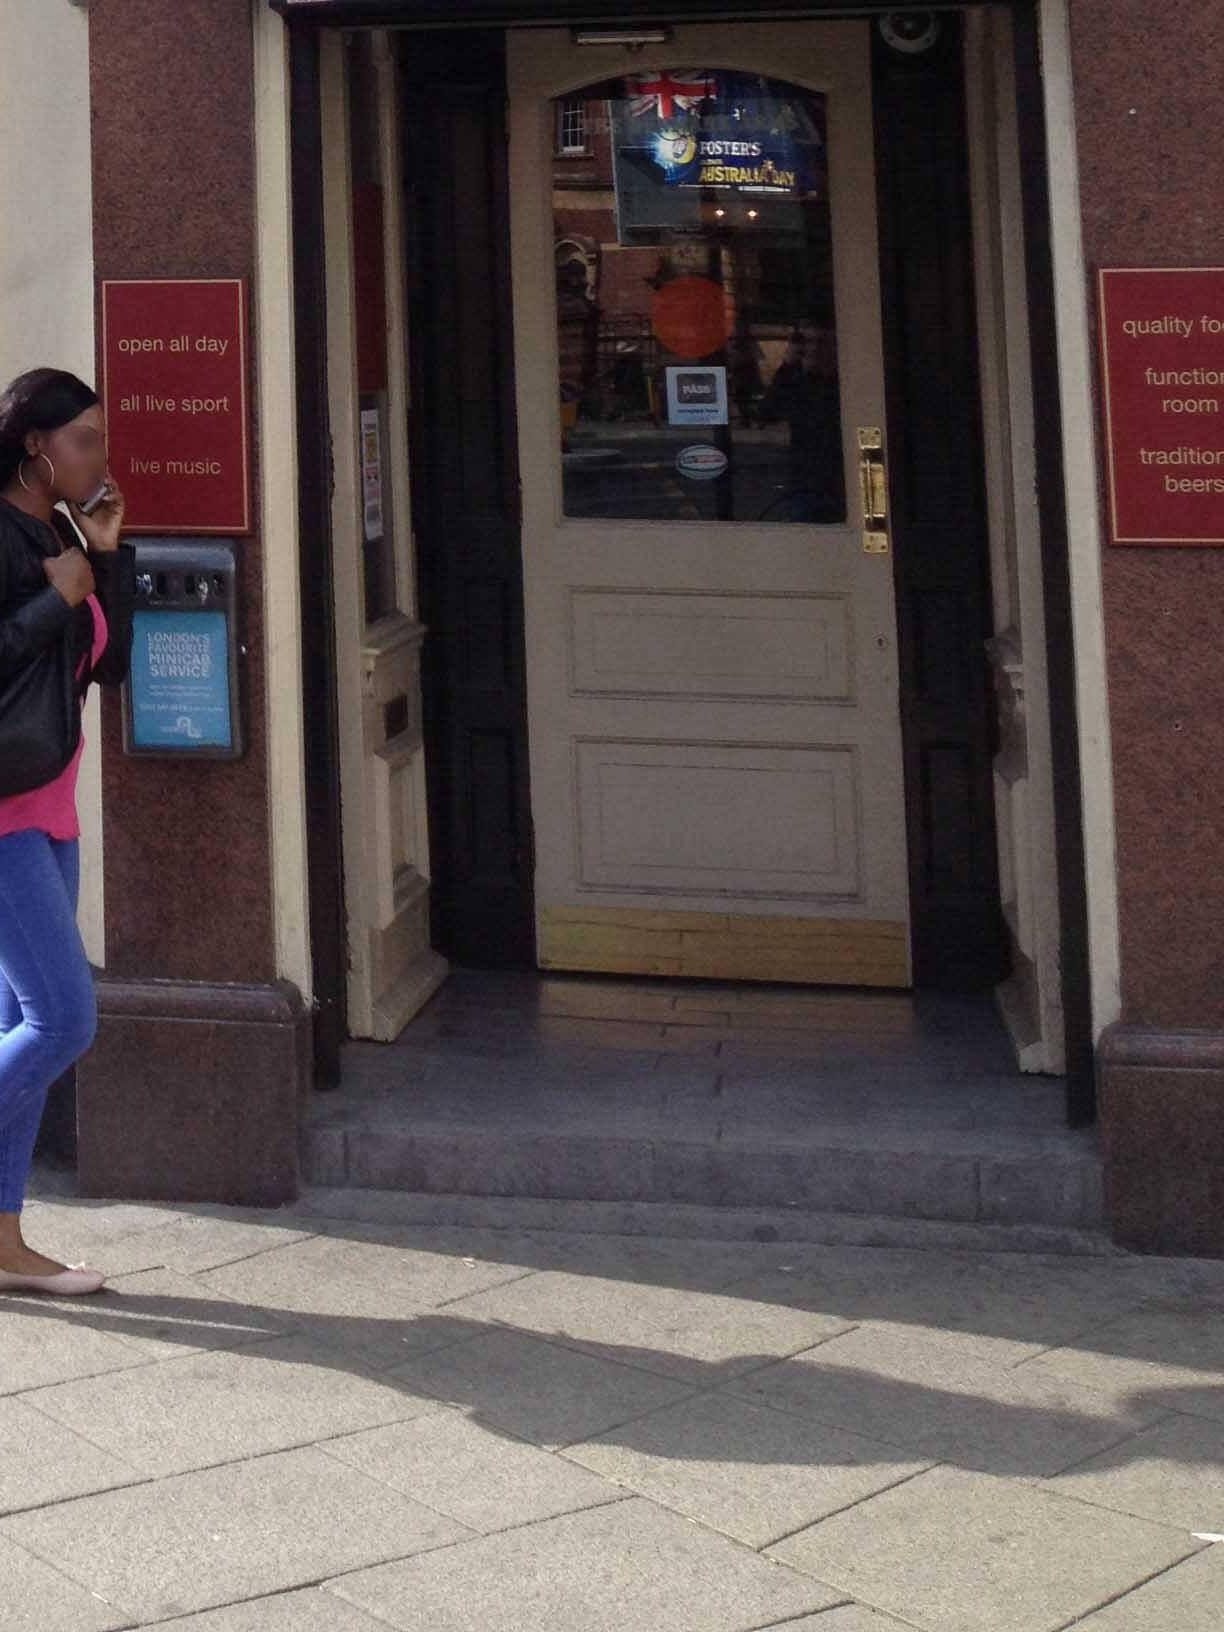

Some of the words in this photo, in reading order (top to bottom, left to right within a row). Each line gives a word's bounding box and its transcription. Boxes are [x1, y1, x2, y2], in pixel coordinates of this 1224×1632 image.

[699, 141, 761, 156] FOSTER'S
[1122, 316, 1194, 338] quality
[118, 338, 164, 356] open
[169, 336, 189, 352] all
[195, 336, 229, 356] day
[120, 395, 140, 412] all
[146, 395, 176, 412] live
[181, 396, 230, 415] sport
[1162, 399, 1219, 413] room
[130, 458, 161, 474] live
[166, 458, 222, 475] music
[1165, 475, 1224, 493] beers
[149, 653, 212, 665] MINICAB
[150, 665, 210, 678] SERVICE
